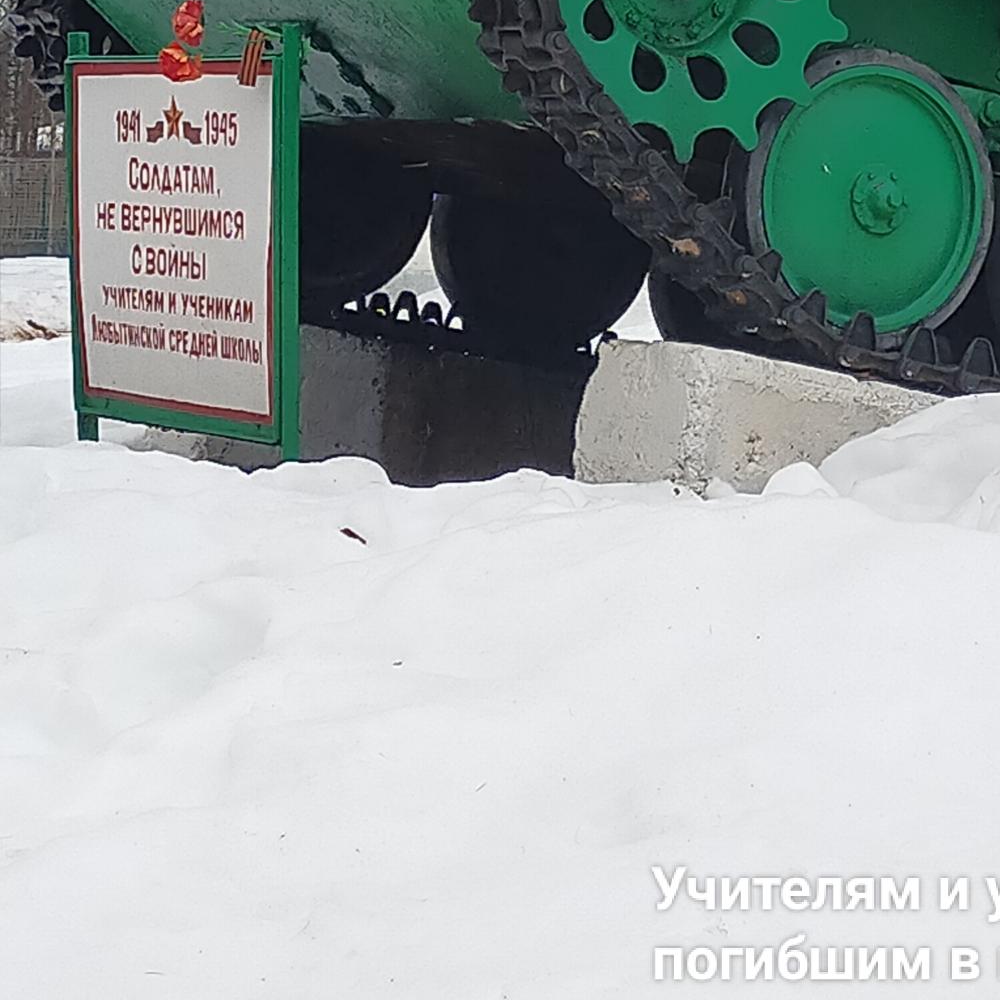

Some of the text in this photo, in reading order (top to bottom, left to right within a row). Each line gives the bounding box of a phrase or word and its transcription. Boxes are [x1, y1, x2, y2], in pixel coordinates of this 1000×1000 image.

[116, 109, 238, 146] 1941 1945
[96, 202, 245, 240] НЕ ВЕРНУВШИМСЯ
[131, 244, 206, 280] С ВОЙНЫ
[102, 285, 254, 323] УЧИТЕЛЯМ И УЧЕНИКАМ
[91, 313, 263, 365] ЛЮБЫТИНСКОЙ СРЕДНЕЙ ШКОЛЫ
